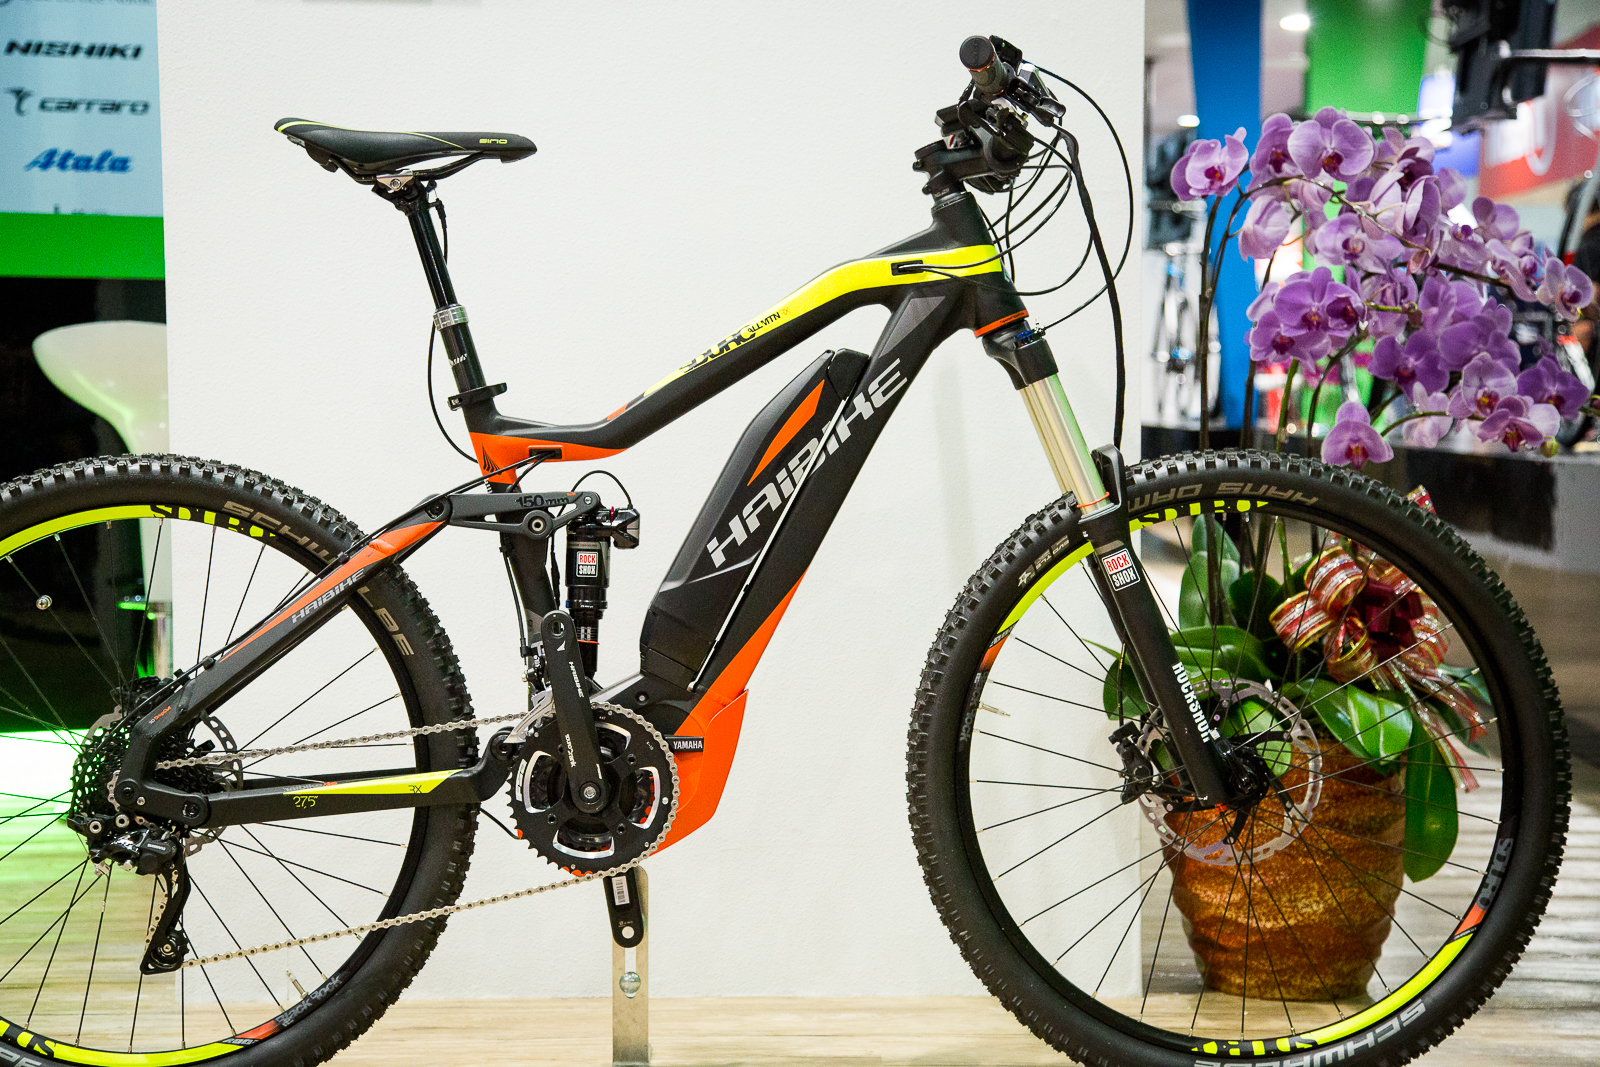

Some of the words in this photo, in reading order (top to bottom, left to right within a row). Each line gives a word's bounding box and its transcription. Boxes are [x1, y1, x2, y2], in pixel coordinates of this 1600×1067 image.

[4, 40, 142, 59] NISHIKI
[24, 147, 132, 173] Atala
[706, 357, 908, 569] HAIBIKE
[579, 554, 596, 564] ROCK
[1105, 553, 1130, 573] ROCK
[578, 565, 596, 575] SHOX
[1112, 567, 1137, 588] SHOX
[291, 568, 365, 624] HAIBIKE
[672, 740, 704, 749] YAMAHA
